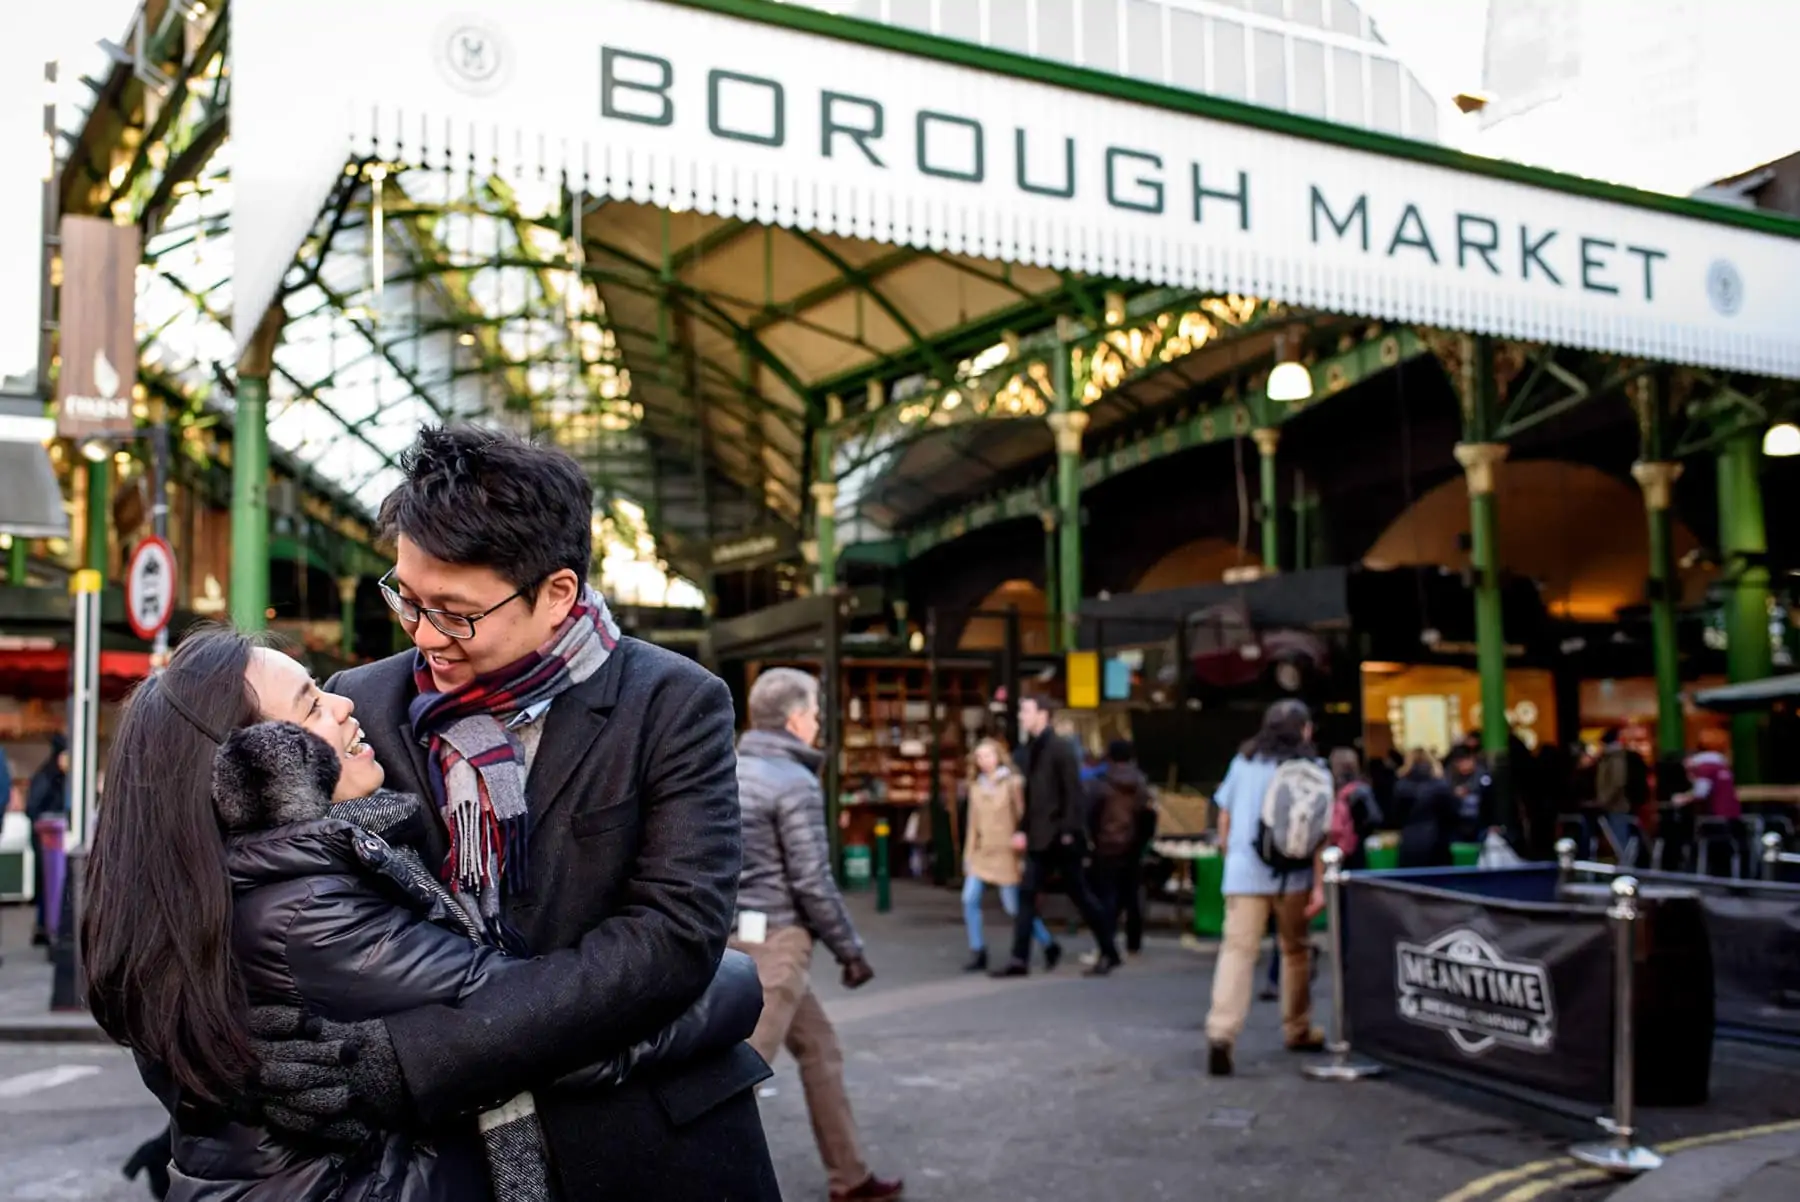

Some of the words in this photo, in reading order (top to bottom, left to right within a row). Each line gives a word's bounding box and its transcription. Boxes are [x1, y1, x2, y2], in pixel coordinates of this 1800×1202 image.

[601, 46, 1249, 231] BOROUGH
[1310, 185, 1667, 301] MARKET
[1402, 953, 1543, 1011] MEANTIME
